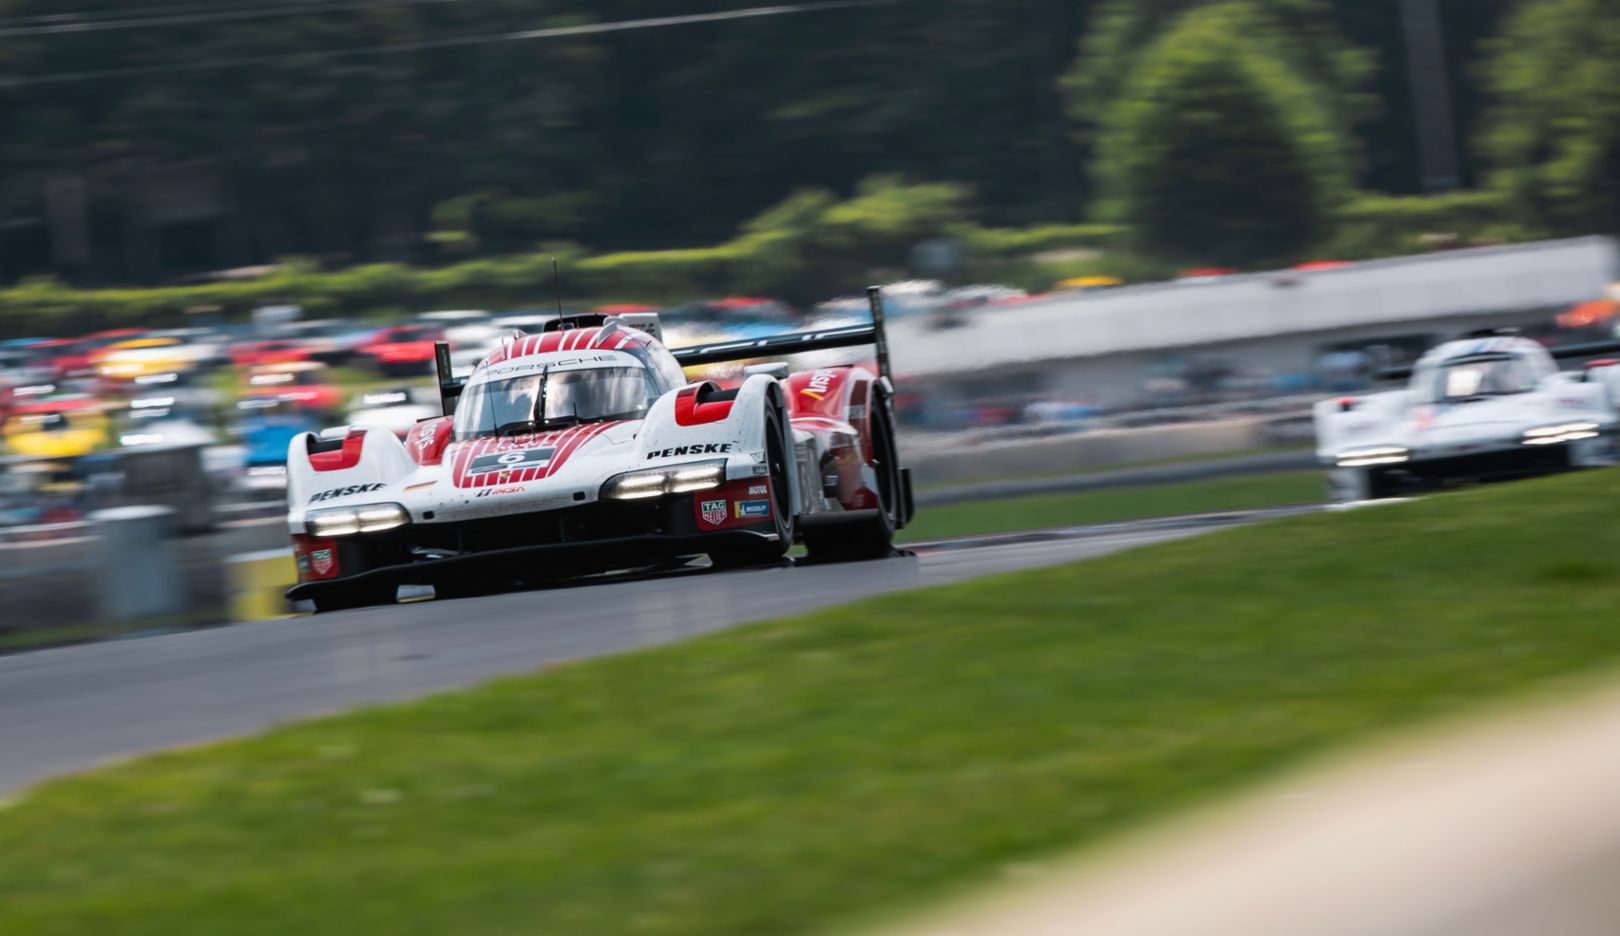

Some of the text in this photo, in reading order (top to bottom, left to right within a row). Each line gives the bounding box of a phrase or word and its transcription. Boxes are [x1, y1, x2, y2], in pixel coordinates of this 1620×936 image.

[484, 354, 619, 376] PORSCHE
[498, 451, 527, 464] 6
[646, 443, 732, 460] PENSKE
[309, 483, 388, 503] PENSKE
[704, 501, 725, 511] TAG
